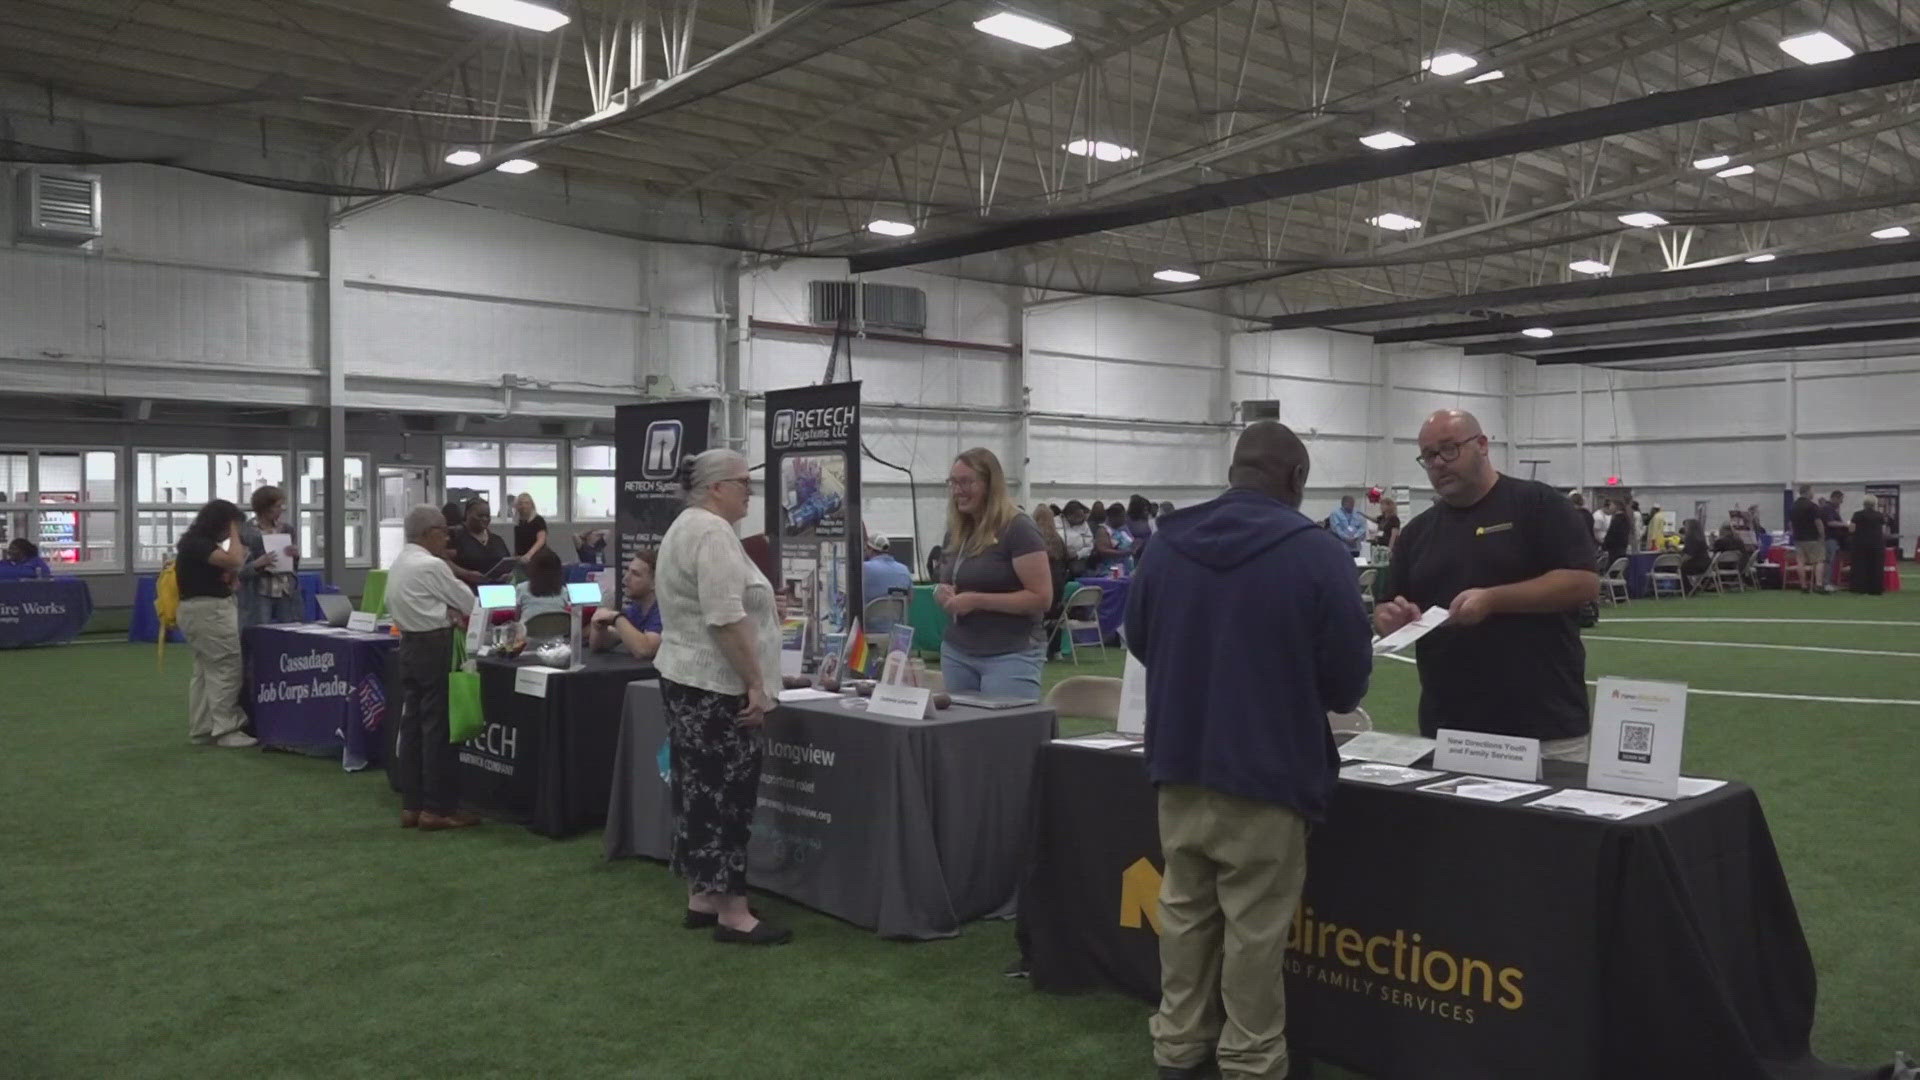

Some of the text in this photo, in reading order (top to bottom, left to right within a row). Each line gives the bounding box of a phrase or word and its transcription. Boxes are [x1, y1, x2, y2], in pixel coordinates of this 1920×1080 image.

[795, 406, 855, 428] RETECH
[794, 425, 848, 441] Systems LLC
[625, 481, 654, 491] RETECH
[22, 602, 66, 614] Works
[280, 649, 334, 672] Cassadaga
[258, 683, 276, 702] Job
[278, 681, 309, 703] Corps
[768, 739, 835, 767] Longview
[1448, 737, 1526, 753] New Directions Youth
[1465, 748, 1489, 759] Family
[1491, 752, 1524, 761] Services
[1306, 966, 1374, 996] FAMILY
[1380, 985, 1475, 1024] SERVICES
